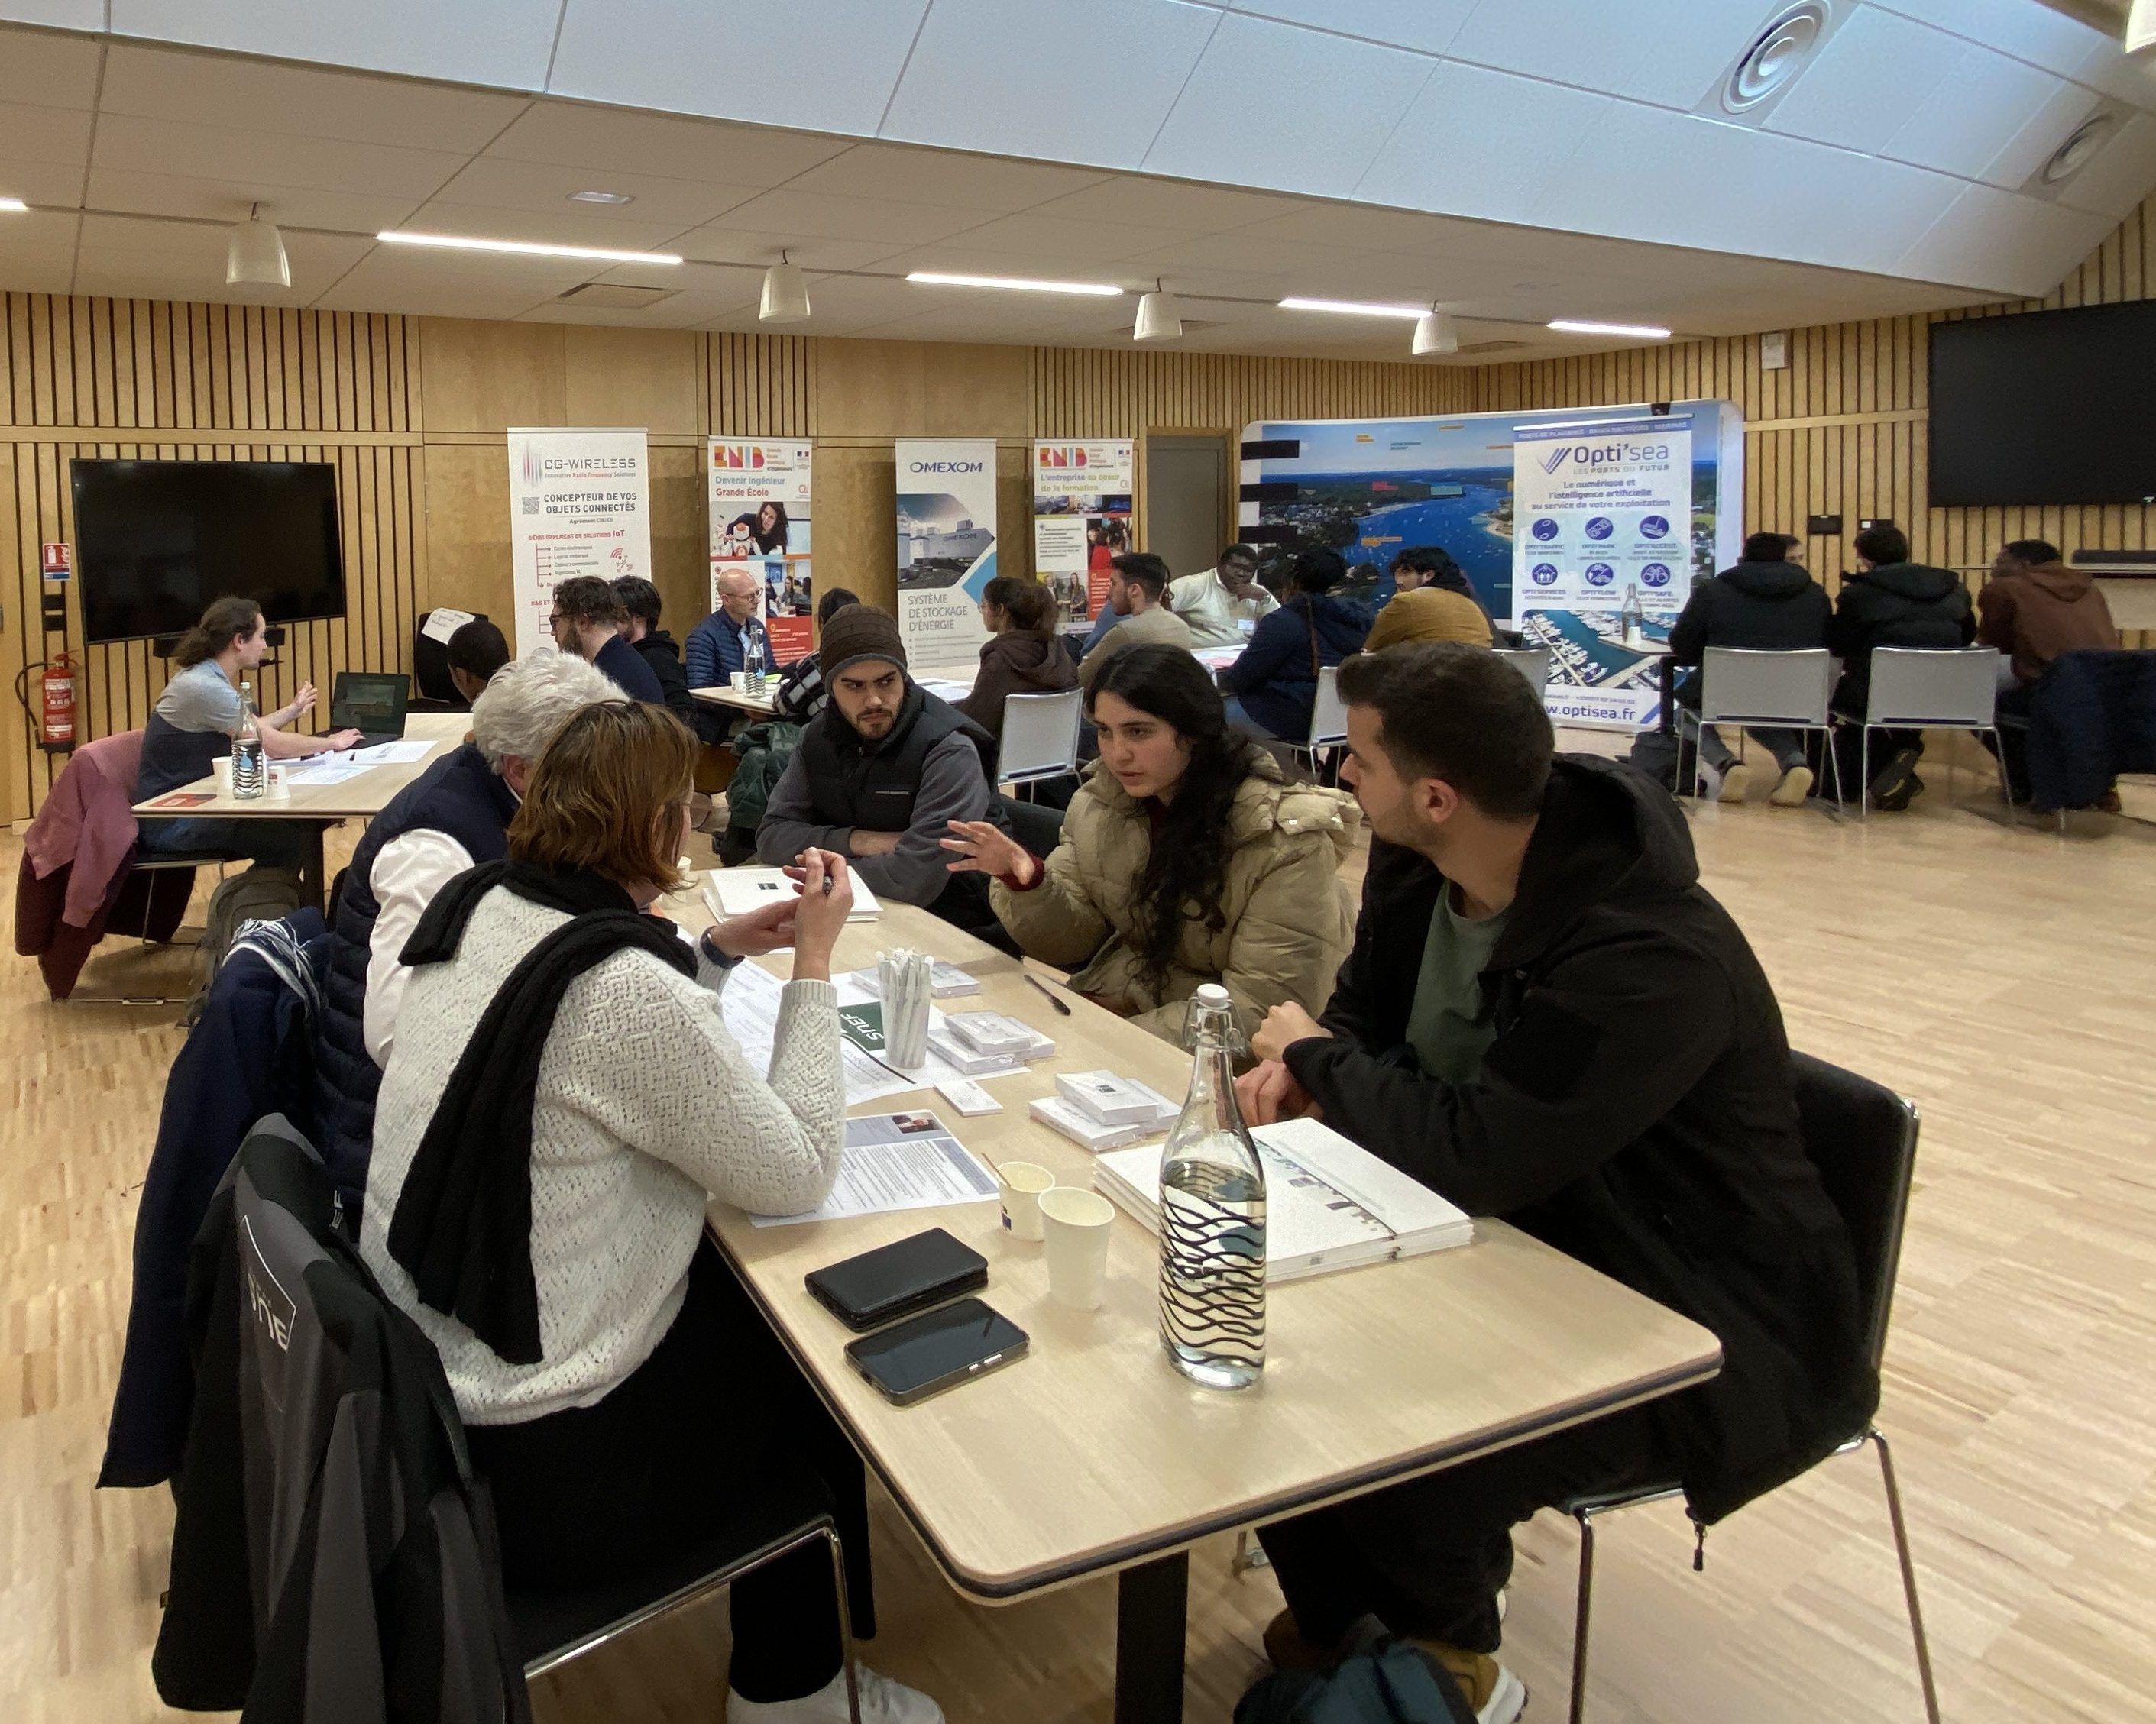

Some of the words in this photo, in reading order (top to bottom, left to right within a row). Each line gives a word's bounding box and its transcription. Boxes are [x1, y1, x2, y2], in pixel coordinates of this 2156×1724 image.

[714, 445, 765, 468] ENIB
[1040, 447, 1088, 467] ENIB
[1574, 443, 1669, 466] Opti'sea
[545, 458, 636, 470] CG-WIRELESS
[910, 461, 983, 473] OMEXOM
[716, 476, 746, 485] Devenir
[1041, 474, 1085, 482] L'entreprise
[1576, 480, 1623, 490] numérique
[716, 488, 745, 496] Grande
[746, 487, 769, 496] École
[1549, 490, 1604, 500] l'intelligence
[1606, 489, 1652, 497] artificielle
[544, 493, 604, 503] CONCEPTEUR
[620, 493, 637, 501] VOS
[546, 505, 581, 514] OBJETS
[583, 502, 635, 513] CONNECTÉS
[1576, 501, 1587, 509] de
[1615, 500, 1670, 509] exploitation
[612, 529, 625, 538] IoT
[908, 593, 948, 606] SYSTÈME
[908, 608, 921, 619] DE
[922, 606, 968, 618] STOCKAGE
[909, 619, 954, 632] D'ÉNERGIE
[1546, 705, 1636, 720] w.optisea.fr
